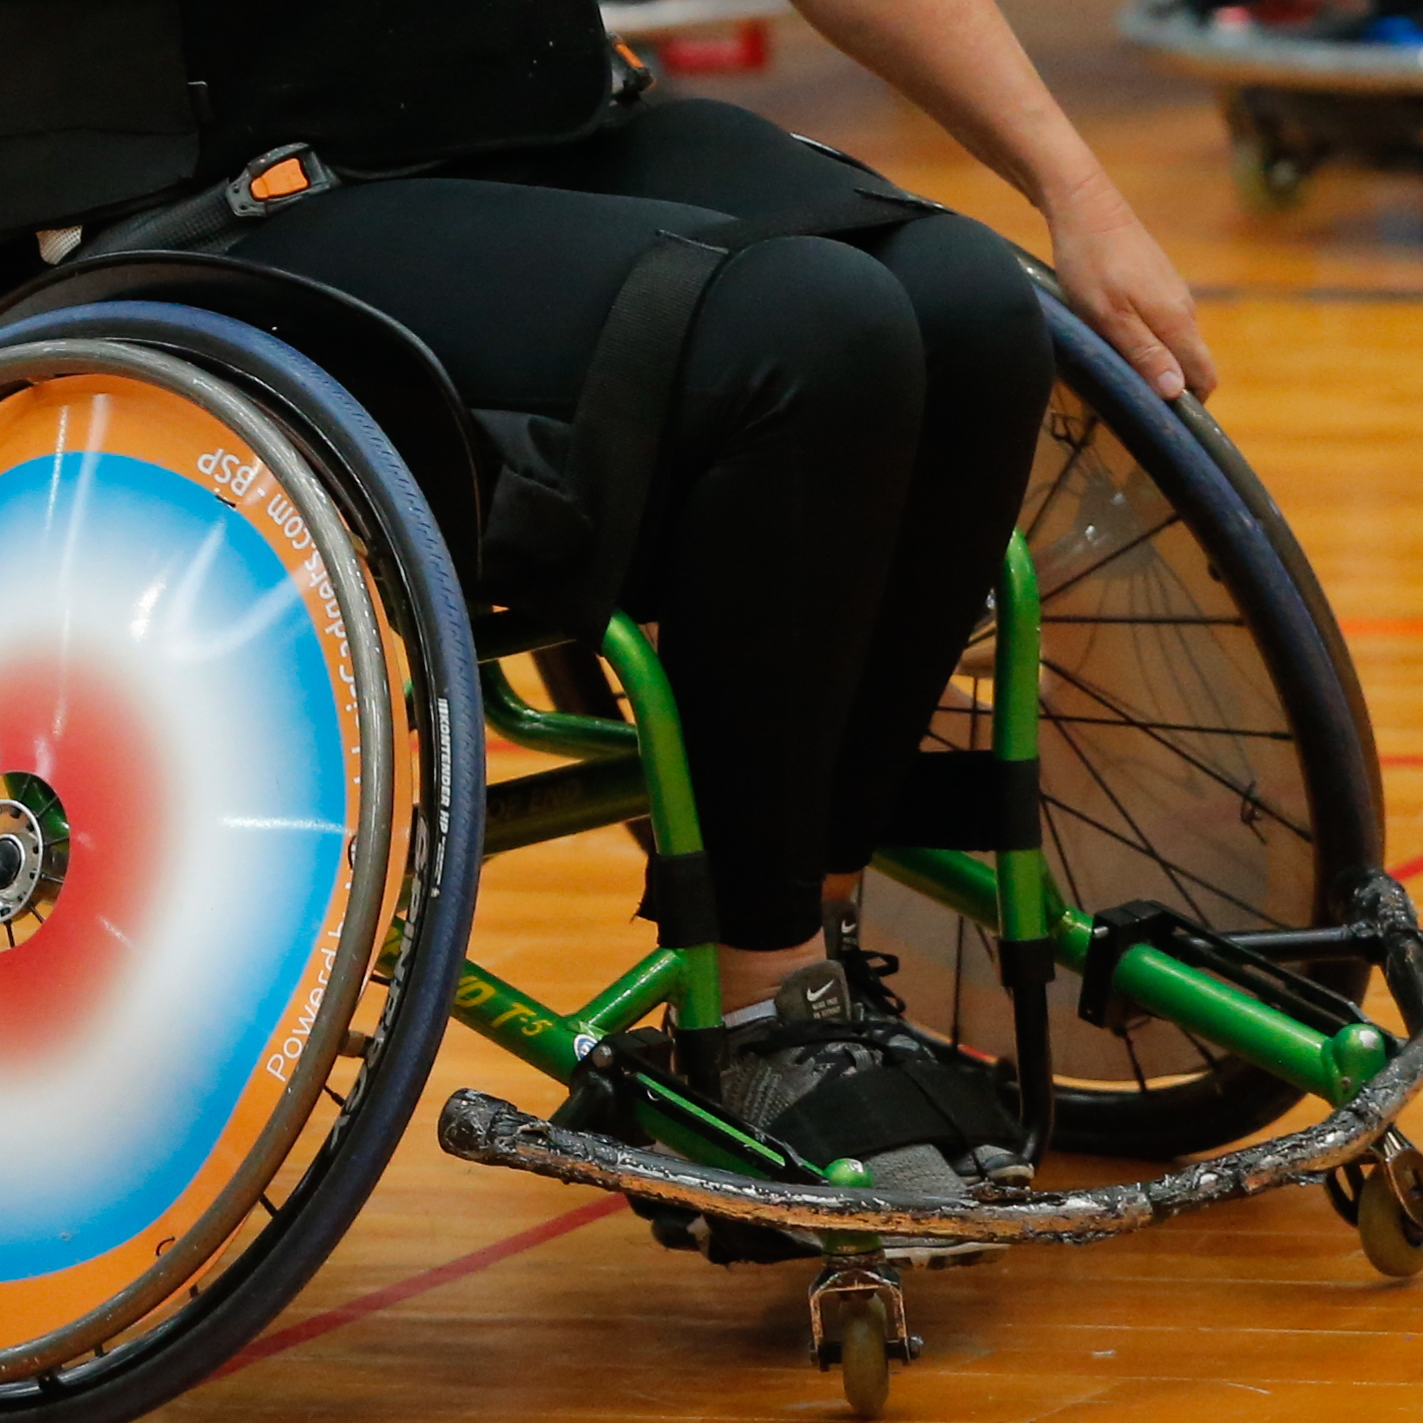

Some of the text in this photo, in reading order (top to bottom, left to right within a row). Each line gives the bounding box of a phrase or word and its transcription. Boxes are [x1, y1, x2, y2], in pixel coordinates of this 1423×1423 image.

[196, 448, 259, 497] BSP
[437, 698, 452, 808] KONTENDER
[438, 809, 451, 835] HP
